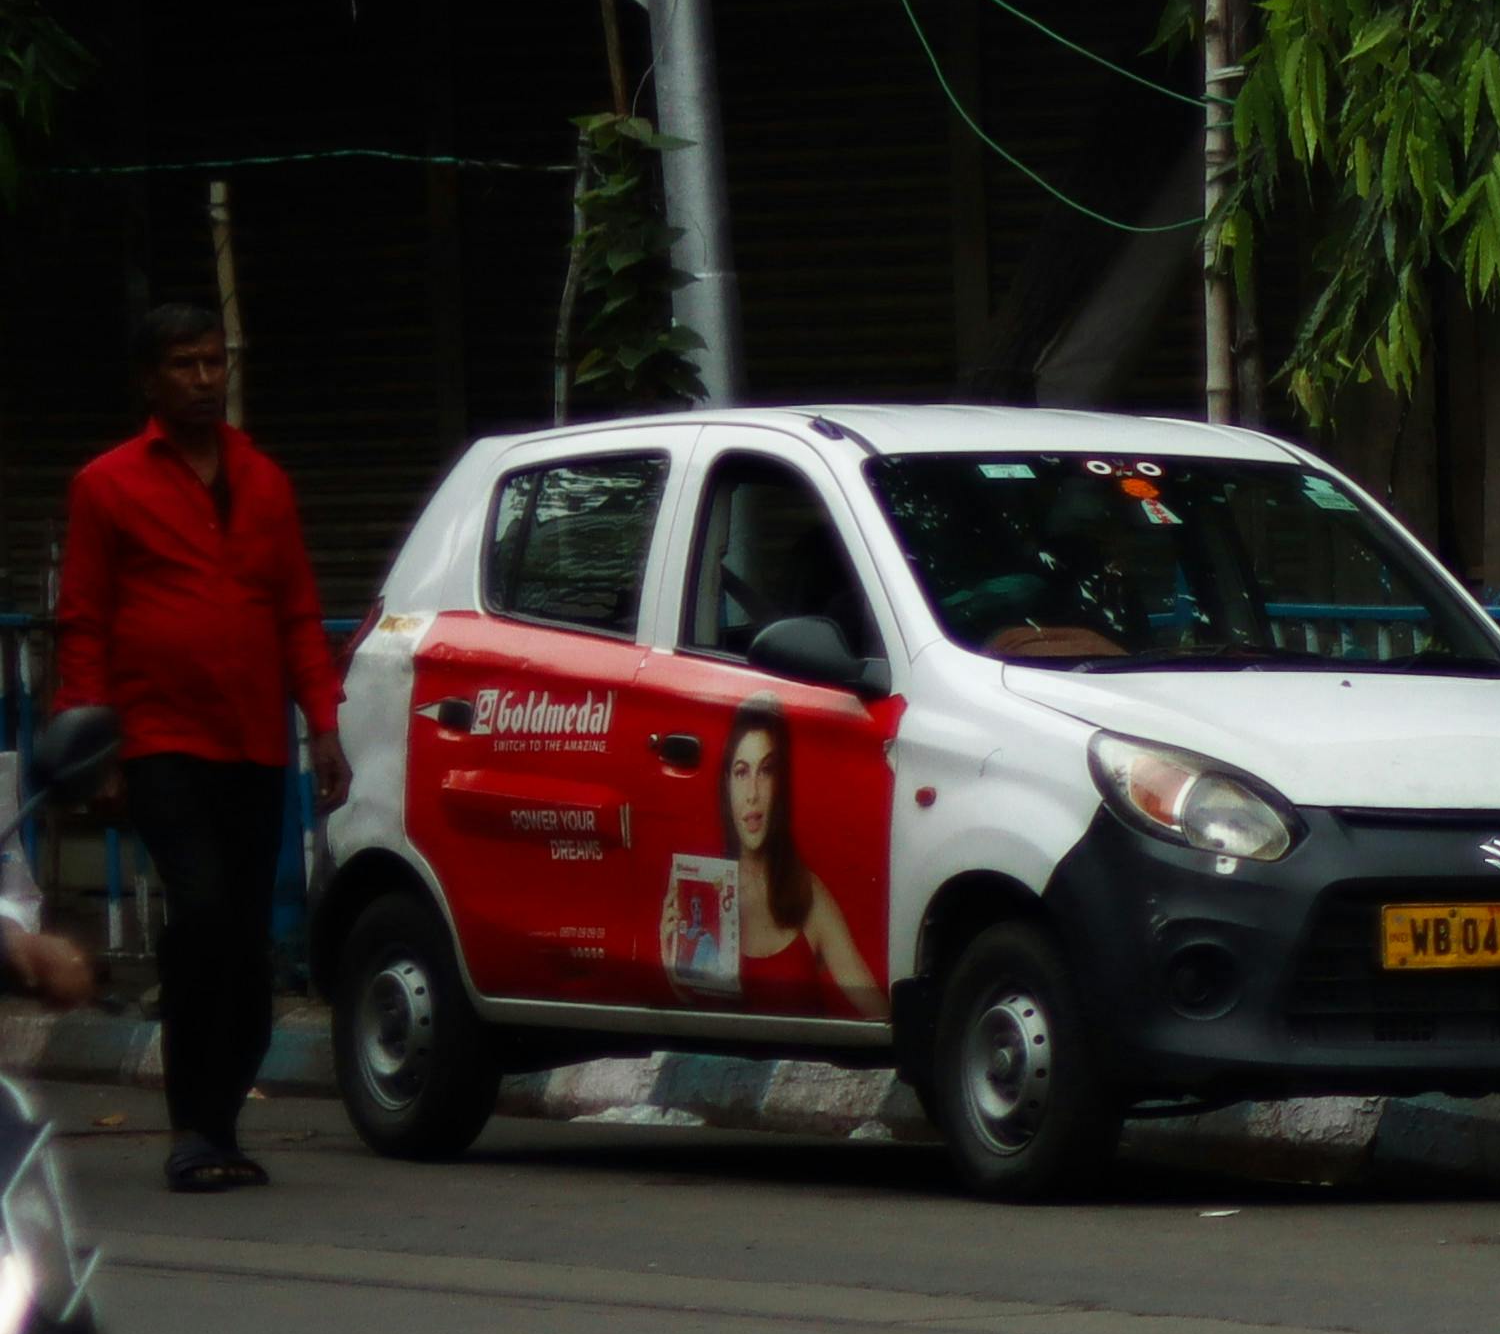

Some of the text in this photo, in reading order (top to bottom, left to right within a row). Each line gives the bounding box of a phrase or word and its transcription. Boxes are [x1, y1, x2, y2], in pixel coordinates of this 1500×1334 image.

[497, 690, 613, 734] Goldmedal
[494, 740, 606, 753] SWITCH TO THE AMAZING
[511, 810, 596, 832] POWER YOUR
[550, 840, 604, 861] DREAMS
[1410, 917, 1451, 956] WB
[1462, 917, 1499, 956] 04
